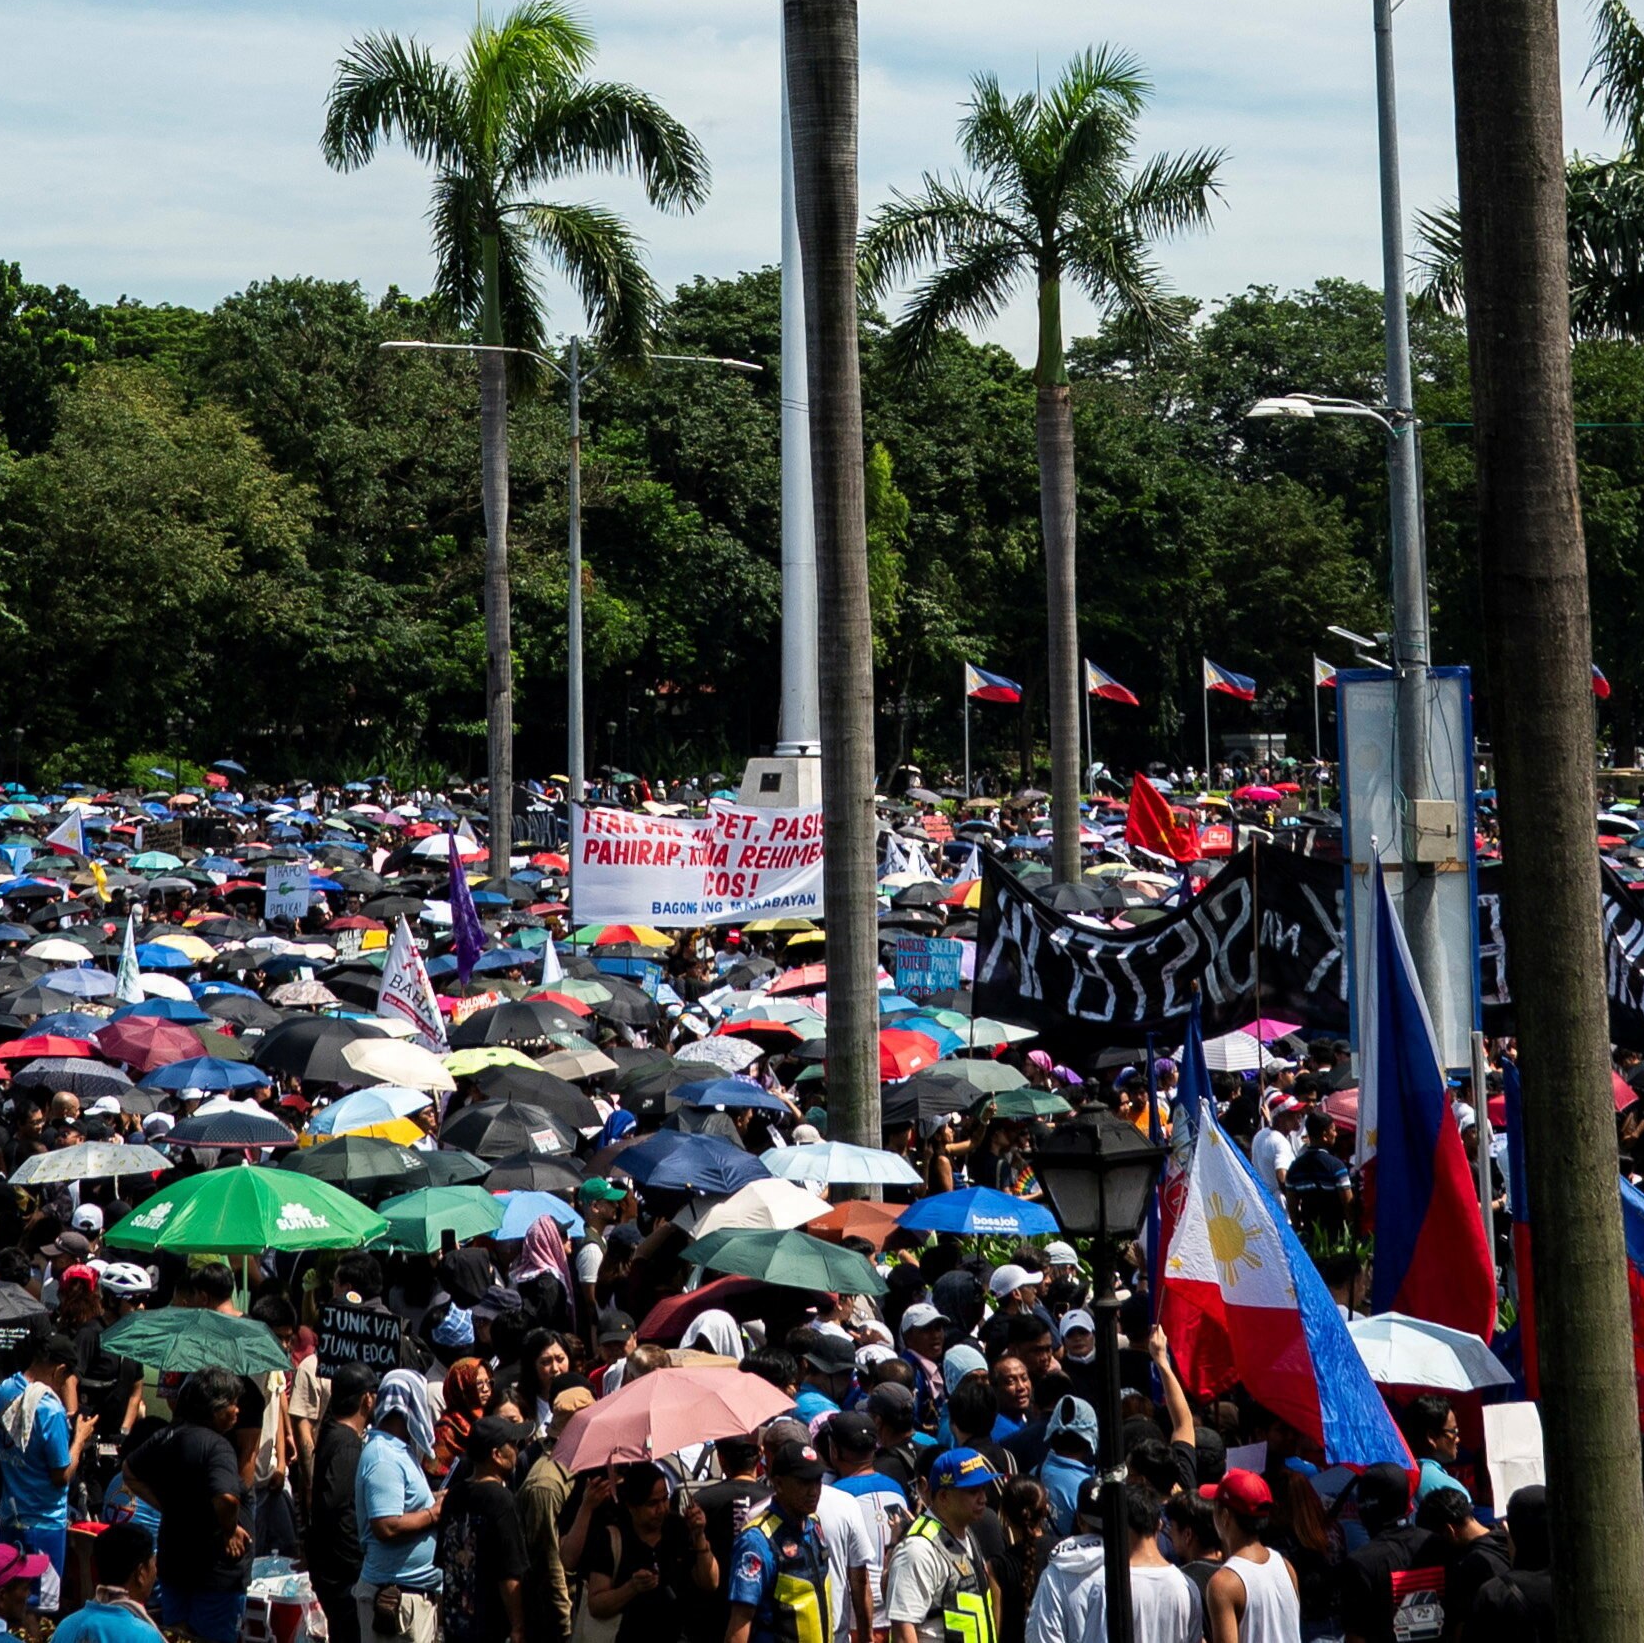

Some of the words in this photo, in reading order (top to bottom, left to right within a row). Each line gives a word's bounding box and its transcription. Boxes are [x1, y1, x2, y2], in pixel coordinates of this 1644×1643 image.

[582, 838, 686, 870] PAHIRAP,
[651, 901, 698, 915] BAGONG
[130, 1213, 168, 1230] SUNTEX
[275, 1214, 330, 1231] SUNTEX
[972, 1214, 1019, 1227] bossjob
[323, 1307, 371, 1334] JUNK
[374, 1316, 400, 1341] VFA
[318, 1333, 359, 1360] JUNK
[362, 1342, 396, 1364] EDCA
